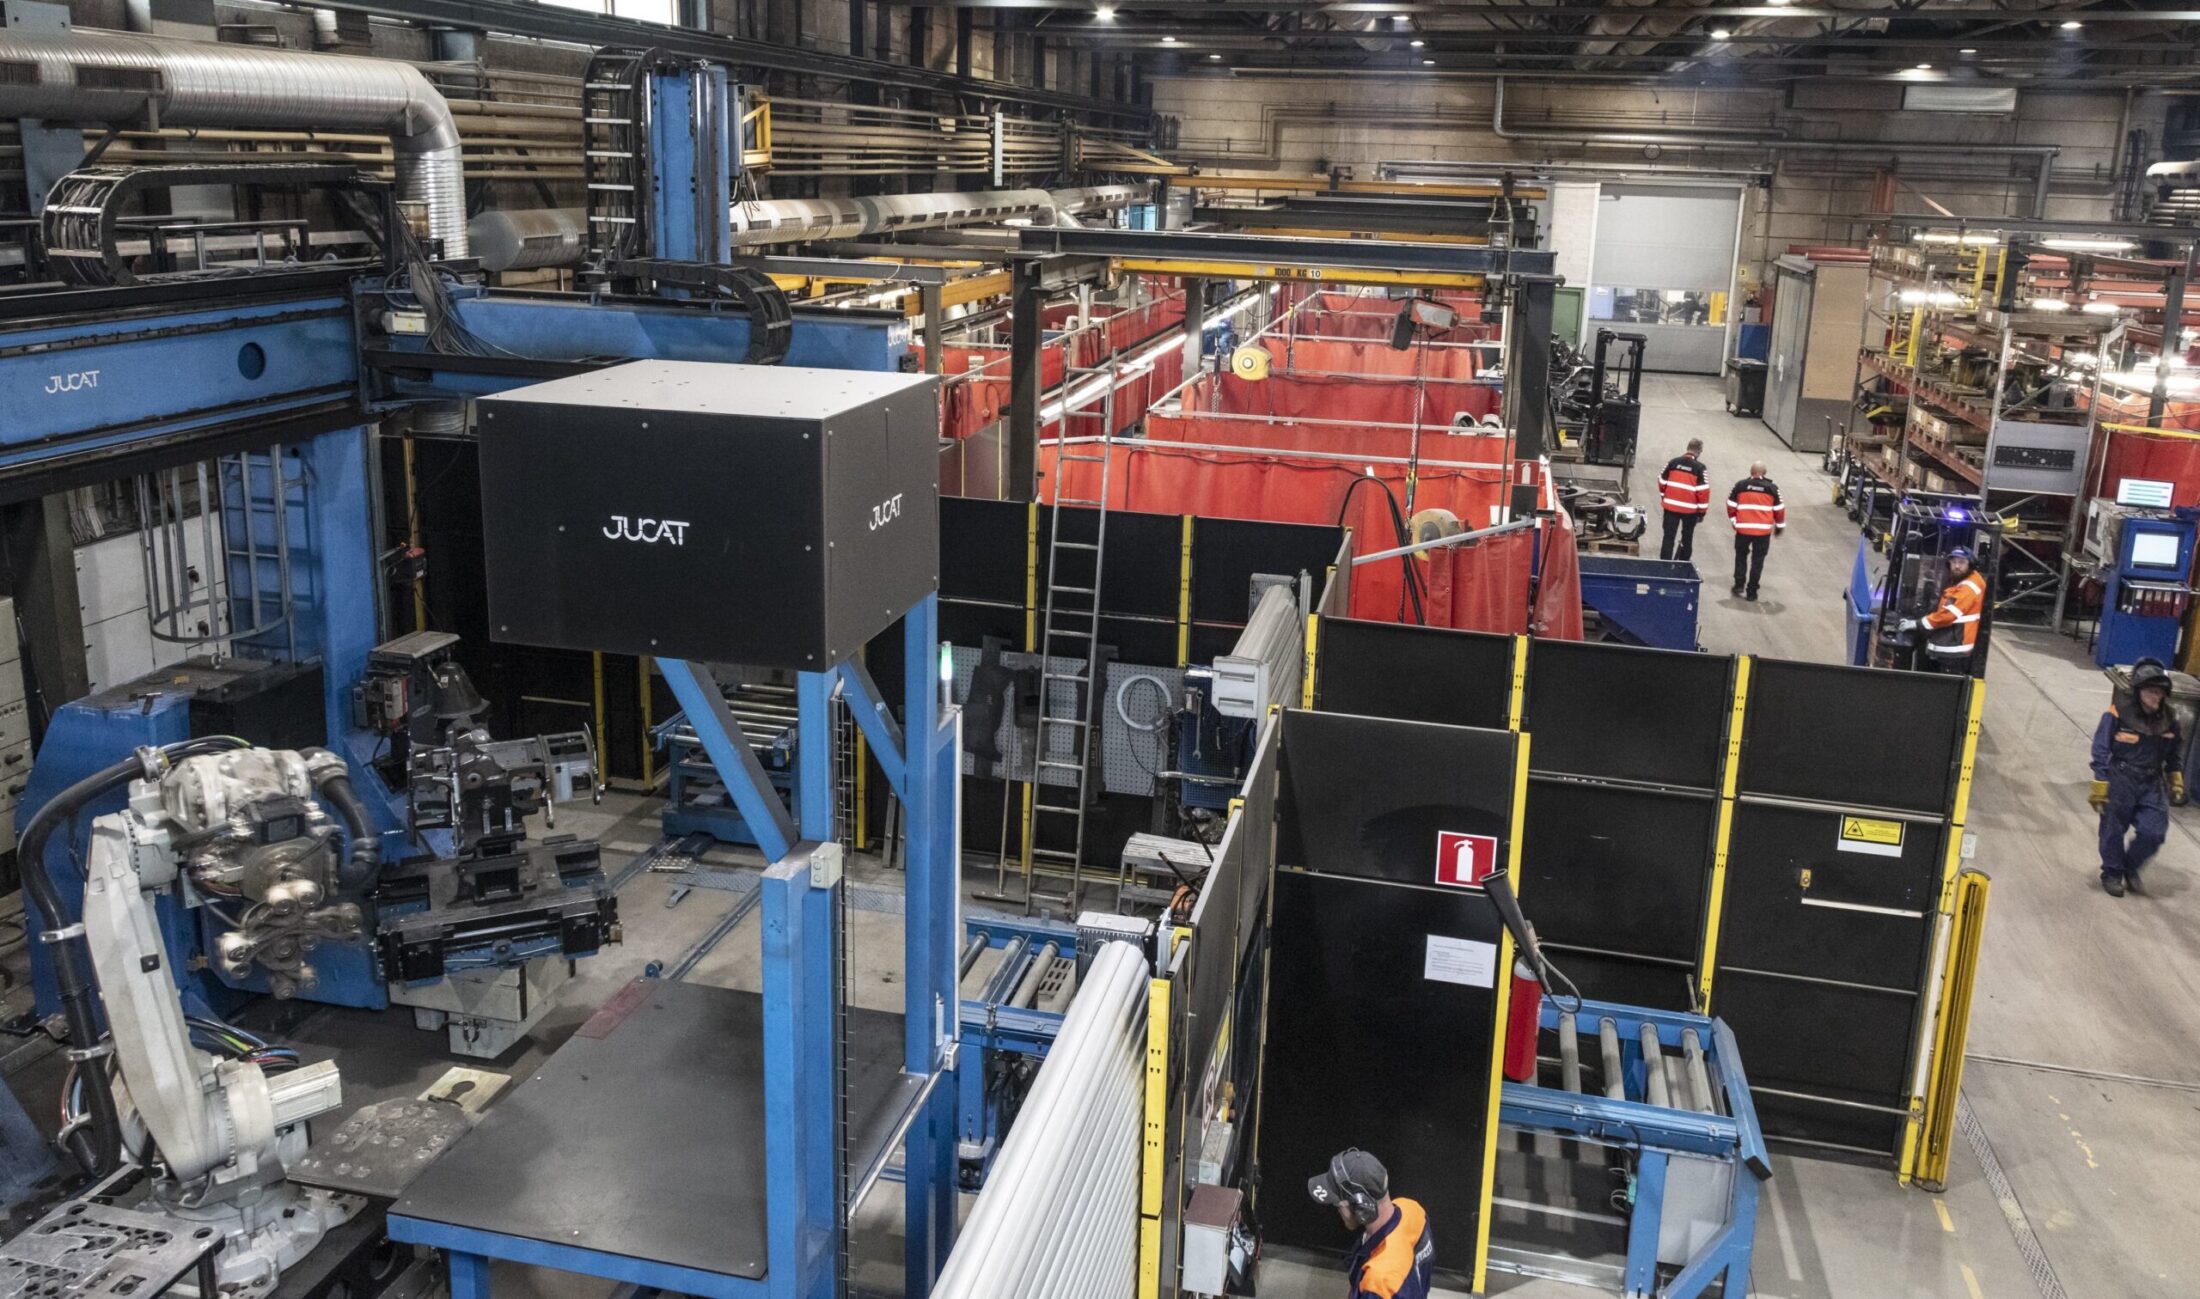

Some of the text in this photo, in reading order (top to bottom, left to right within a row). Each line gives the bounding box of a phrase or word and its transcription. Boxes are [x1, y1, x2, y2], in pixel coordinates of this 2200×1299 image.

[1274, 267, 1321, 278] 1000 KG 10
[44, 370, 101, 394] JUCAT
[869, 493, 903, 531] JUCAT
[602, 515, 691, 546] JUCAT
[1312, 1184, 1328, 1203] 22
